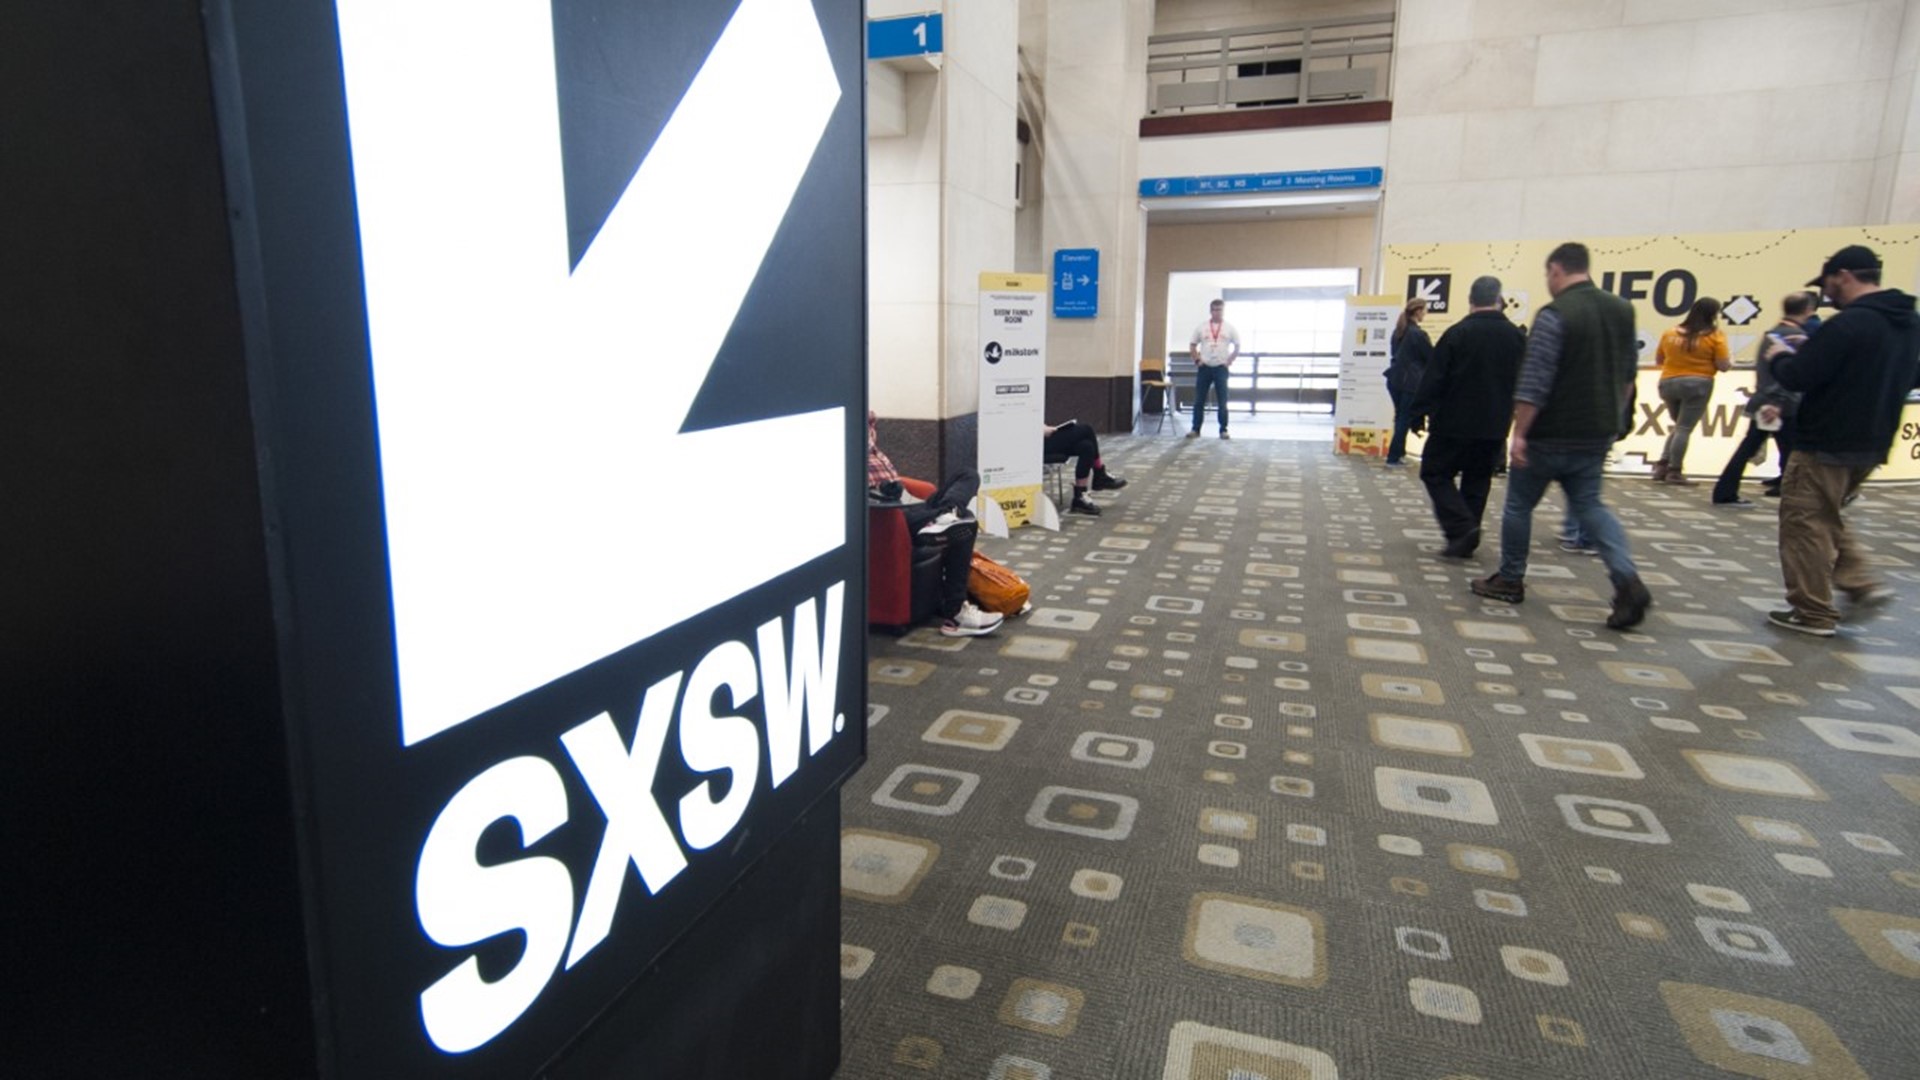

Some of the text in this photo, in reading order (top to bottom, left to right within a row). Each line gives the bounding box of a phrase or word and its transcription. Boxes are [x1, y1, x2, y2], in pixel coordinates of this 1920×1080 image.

[912, 22, 927, 47] 1
[1261, 177, 1282, 187] Level
[1294, 175, 1326, 185] Meeting
[1327, 173, 1356, 183] Rooms
[1062, 254, 1092, 262] Elevator
[1433, 301, 1447, 310] GO
[994, 308, 1034, 316] SXSW FAMILY
[1004, 347, 1039, 357] milkstork
